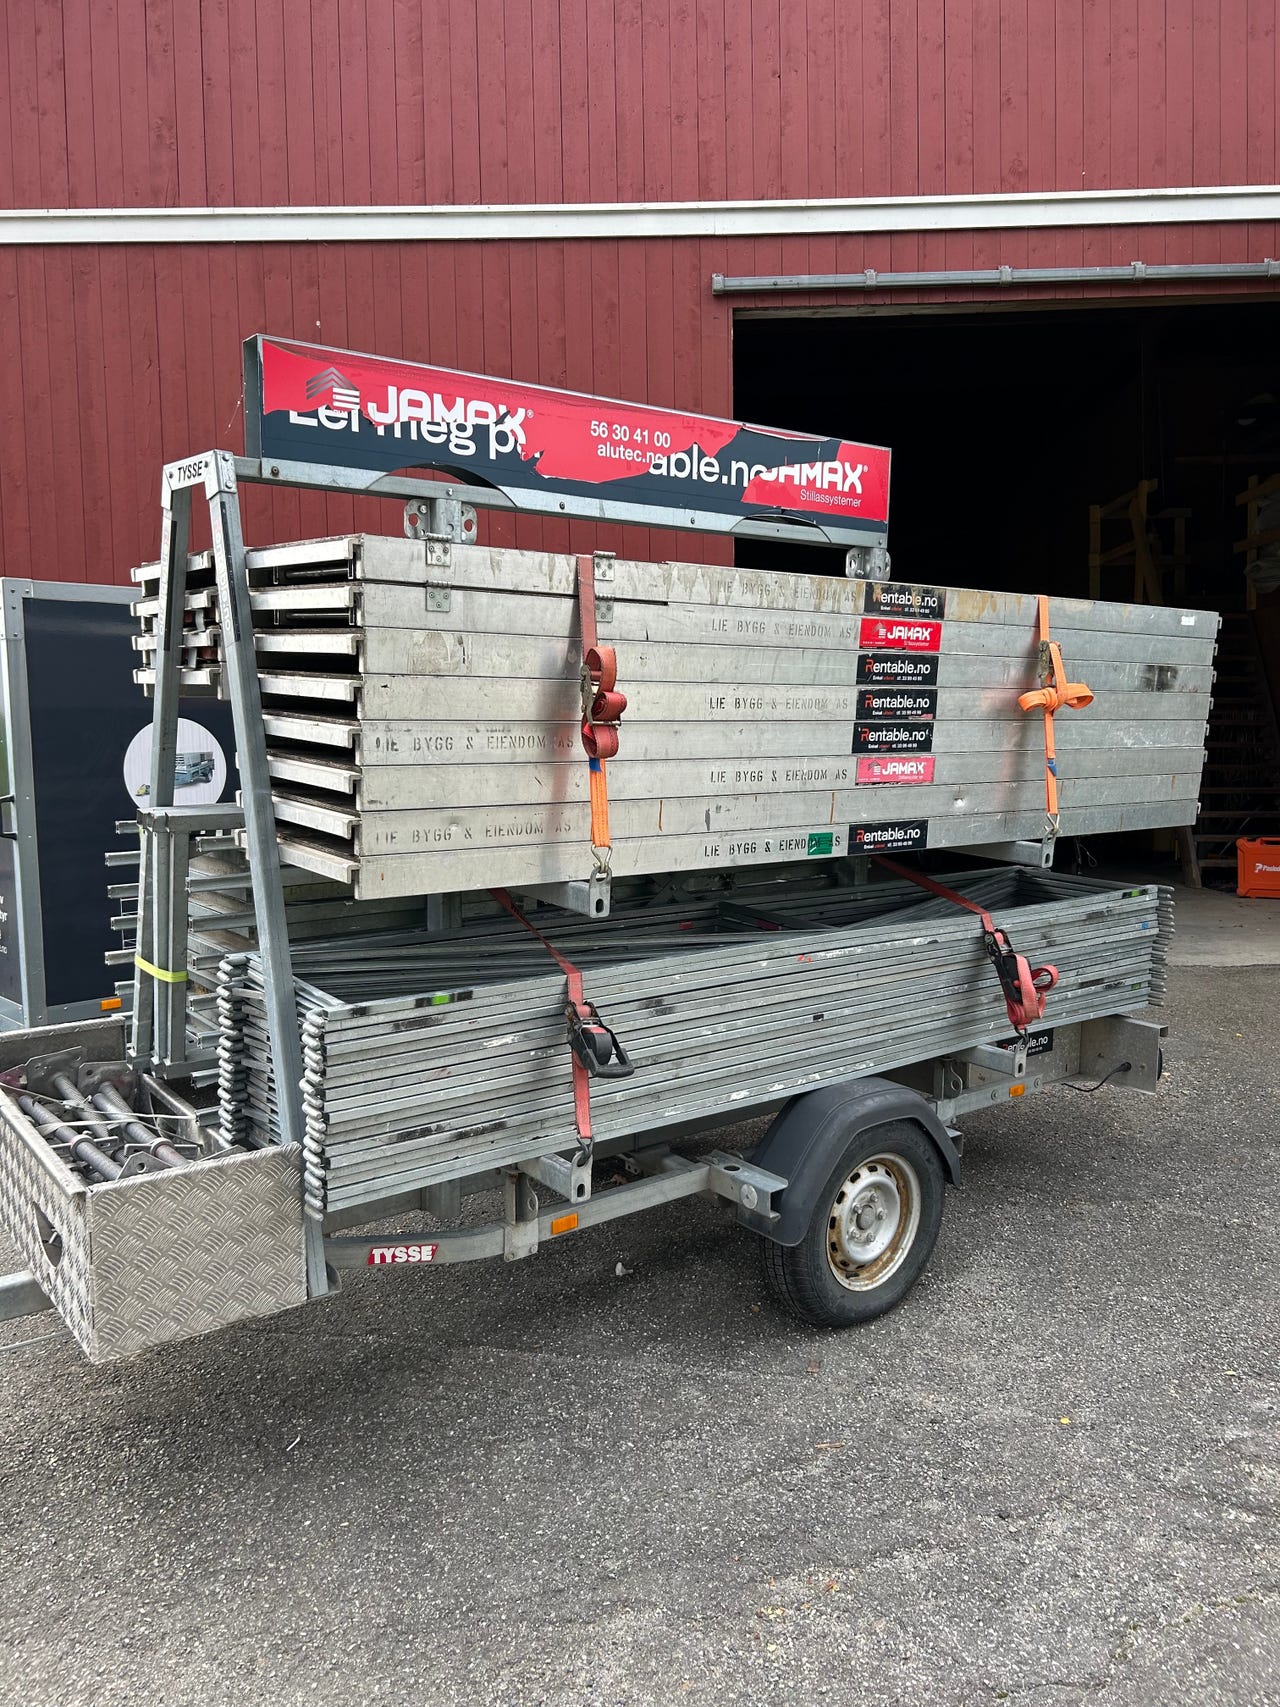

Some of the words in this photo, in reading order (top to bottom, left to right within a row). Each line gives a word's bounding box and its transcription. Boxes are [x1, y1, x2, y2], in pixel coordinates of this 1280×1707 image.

[590, 420, 609, 438] 56
[612, 424, 630, 442] 30
[633, 428, 649, 445] 41
[654, 431, 671, 448] 00
[177, 460, 203, 484] TYSSE
[800, 489, 861, 508] Stillassystemer
[873, 591, 938, 607] Rentable.no
[712, 618, 728, 632] LIE
[737, 620, 766, 633] BYGG
[789, 623, 831, 638] EIENDOM
[839, 626, 851, 639] AS
[887, 626, 930, 641] JAMAX
[865, 659, 931, 674] Rentable.no
[709, 697, 725, 710] LIE
[734, 697, 763, 710] BYGG
[864, 695, 929, 708] Rentable.no
[375, 737, 399, 752] IE
[413, 736, 453, 751] BYGG
[487, 735, 546, 749] EIENDOM
[558, 734, 574, 748] AS
[860, 728, 926, 742] Rentable.no
[710, 771, 726, 783] LIE
[736, 770, 763, 782] BYGG
[786, 769, 828, 781] EIENDOM
[835, 768, 847, 780] AS
[882, 762, 924, 775] JAMAX
[412, 829, 452, 844] BYGG
[485, 822, 544, 838] EIENDOM
[555, 822, 572, 834] AS
[856, 827, 921, 843] Rentable.no
[704, 845, 720, 857] LIE
[729, 842, 757, 855] BYGG
[372, 1245, 433, 1264] TYSSE
